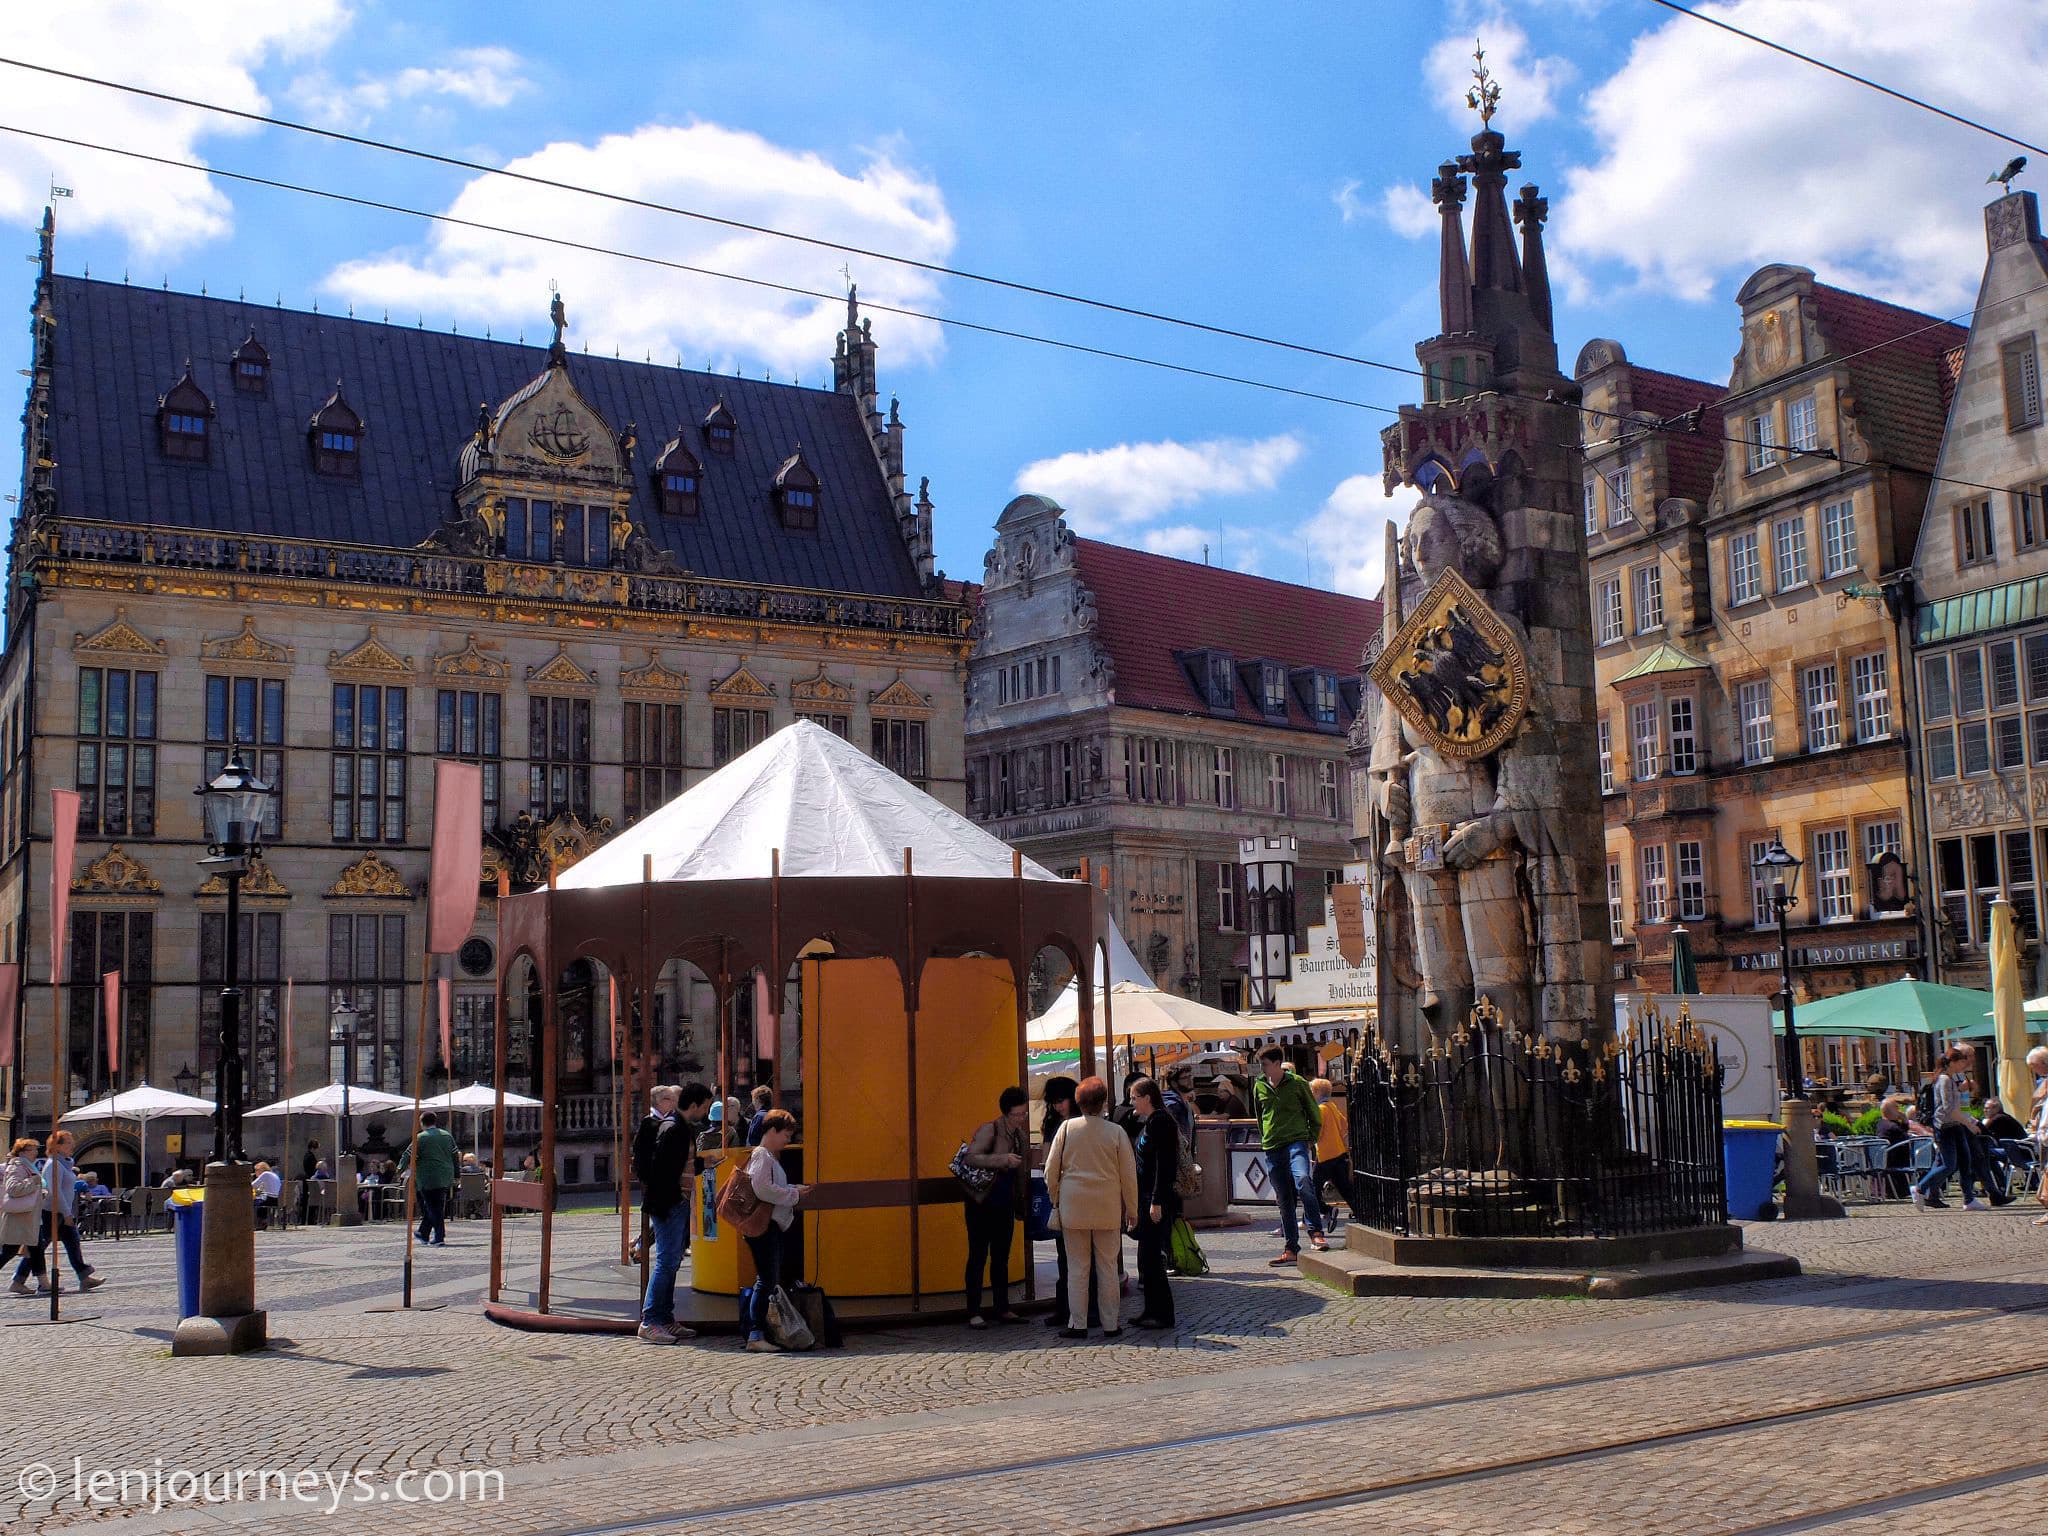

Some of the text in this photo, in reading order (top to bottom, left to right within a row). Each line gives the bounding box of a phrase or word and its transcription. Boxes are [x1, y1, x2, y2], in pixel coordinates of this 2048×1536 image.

[1299, 955, 1355, 975] Bauernbro
[1741, 943, 1902, 969] RATH APOTHEKE
